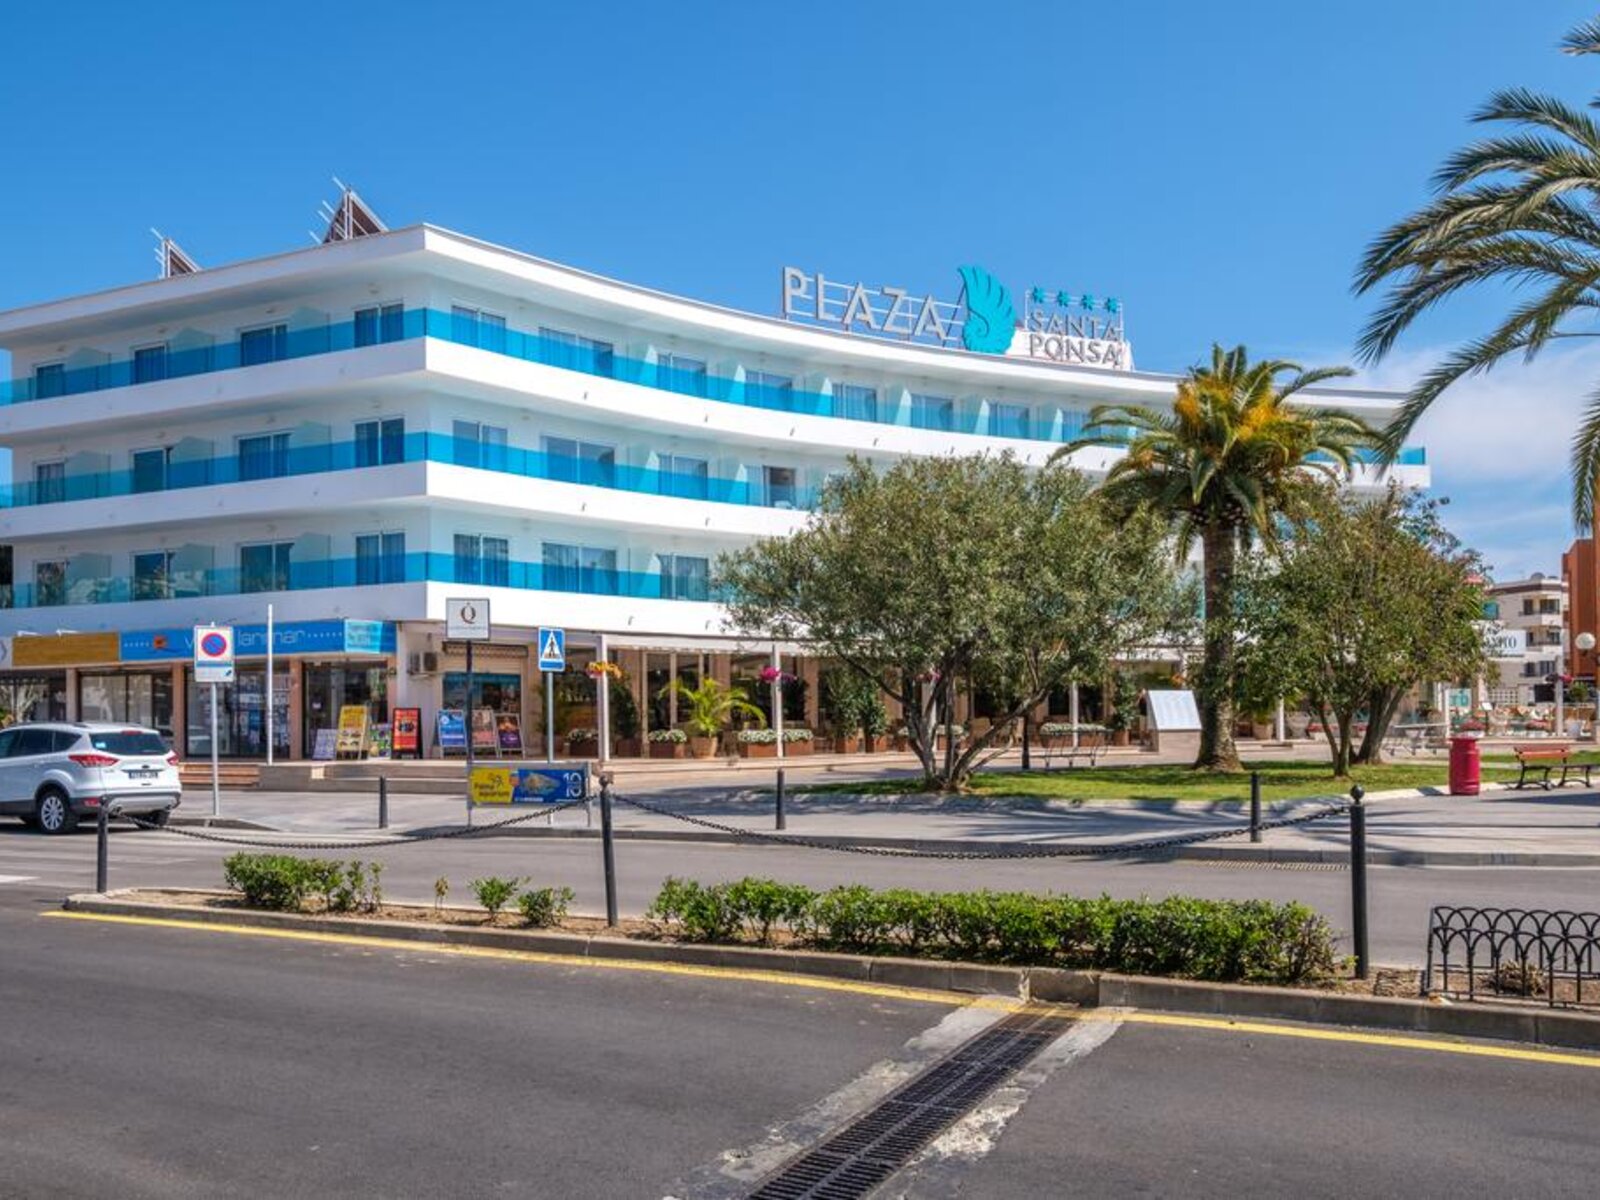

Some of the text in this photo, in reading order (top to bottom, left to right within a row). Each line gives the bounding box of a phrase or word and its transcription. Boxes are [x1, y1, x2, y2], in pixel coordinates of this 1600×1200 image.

[783, 266, 946, 341] PLAZA
[1030, 309, 1119, 342] SANTA
[1029, 333, 1119, 366] PONSA
